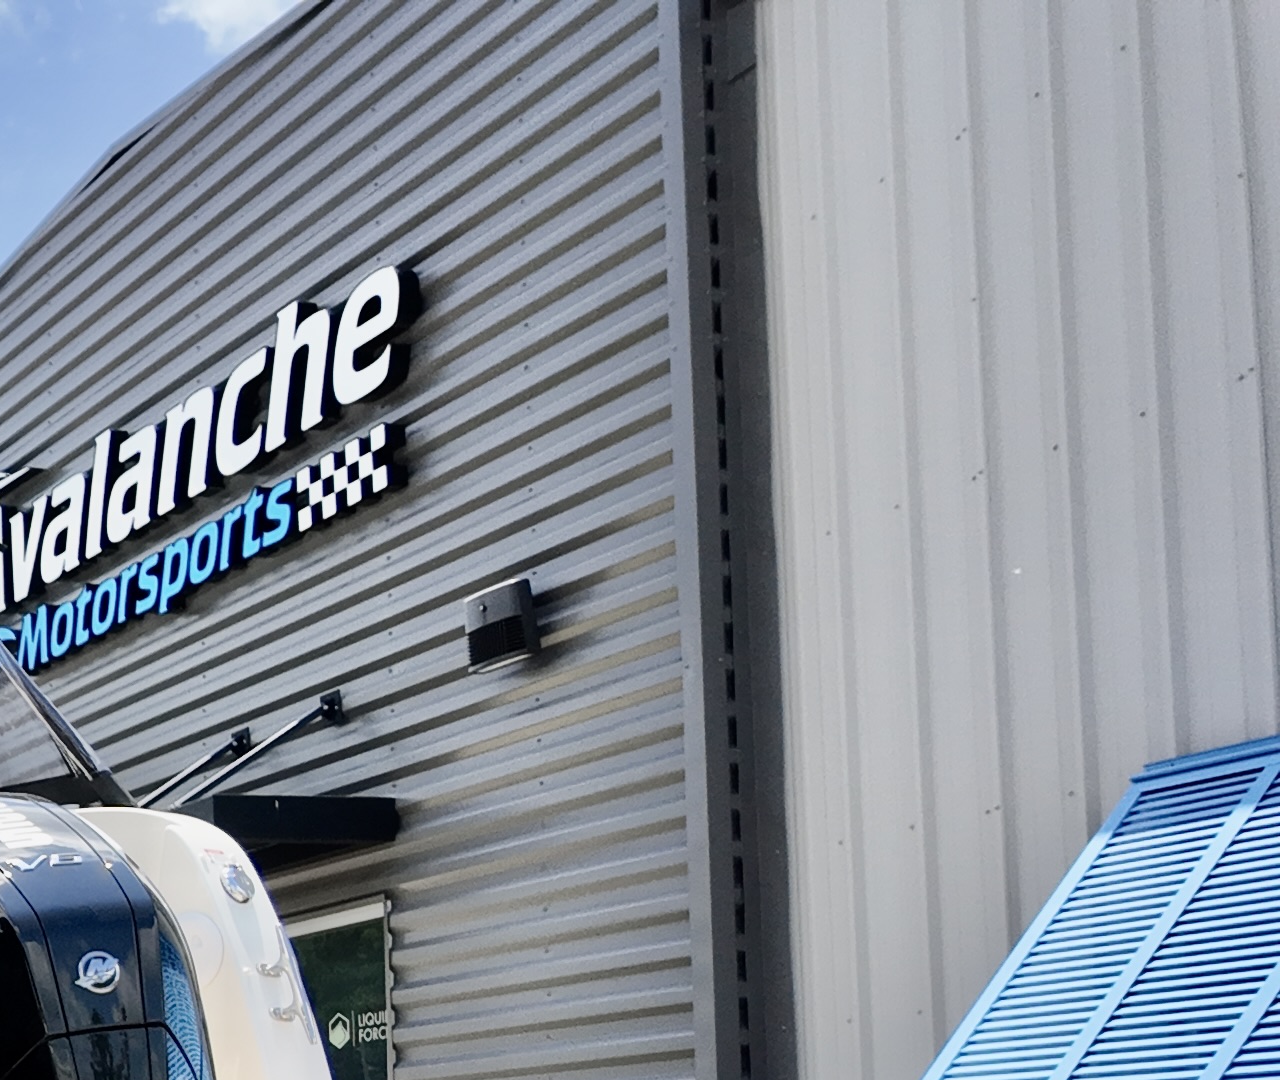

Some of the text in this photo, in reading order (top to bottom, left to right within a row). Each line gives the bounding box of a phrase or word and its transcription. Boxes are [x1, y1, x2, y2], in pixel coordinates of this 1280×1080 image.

[18, 480, 292, 670] Motorsports
[5, 853, 83, 872] V6
[357, 1010, 387, 1028] LIQUI
[358, 1025, 387, 1043] FORC
